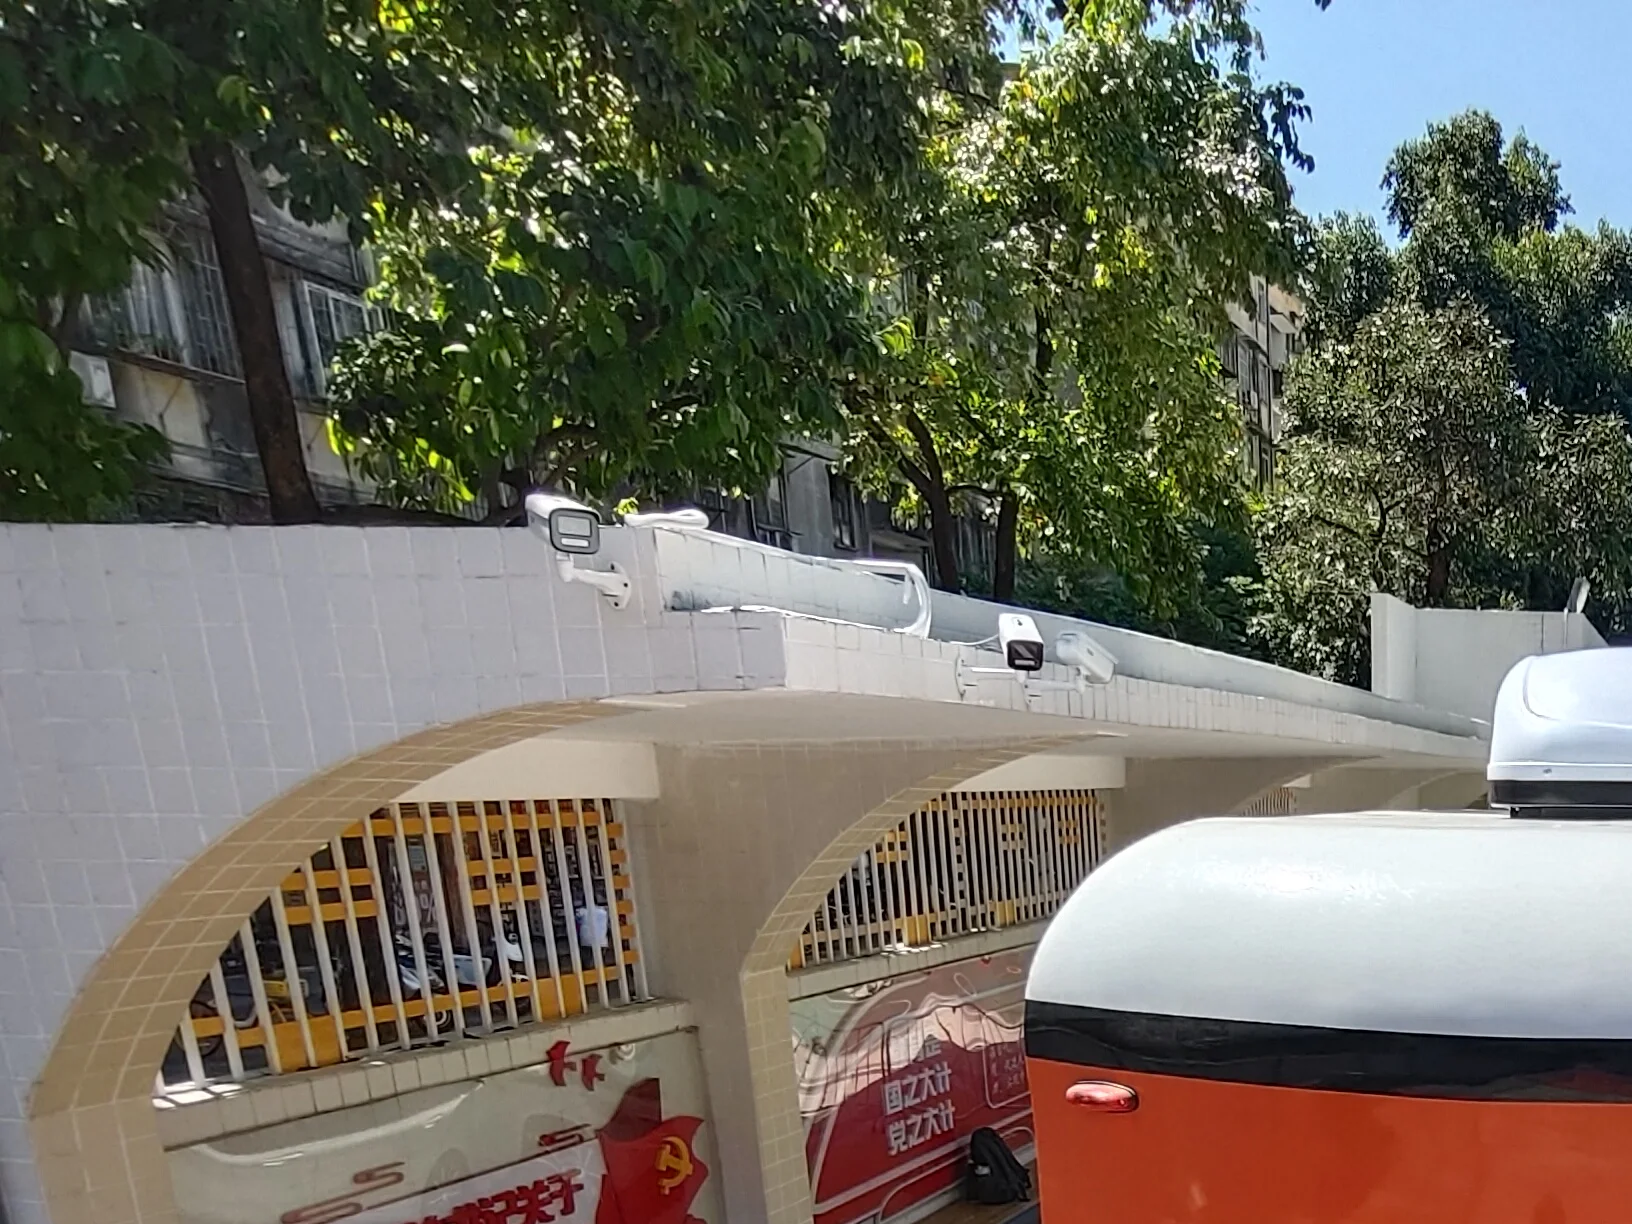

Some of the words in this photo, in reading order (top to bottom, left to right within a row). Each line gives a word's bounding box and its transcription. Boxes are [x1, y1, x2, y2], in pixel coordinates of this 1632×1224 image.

[884, 1060, 952, 1117] 国之大计
[887, 1099, 956, 1156] 党之大计
